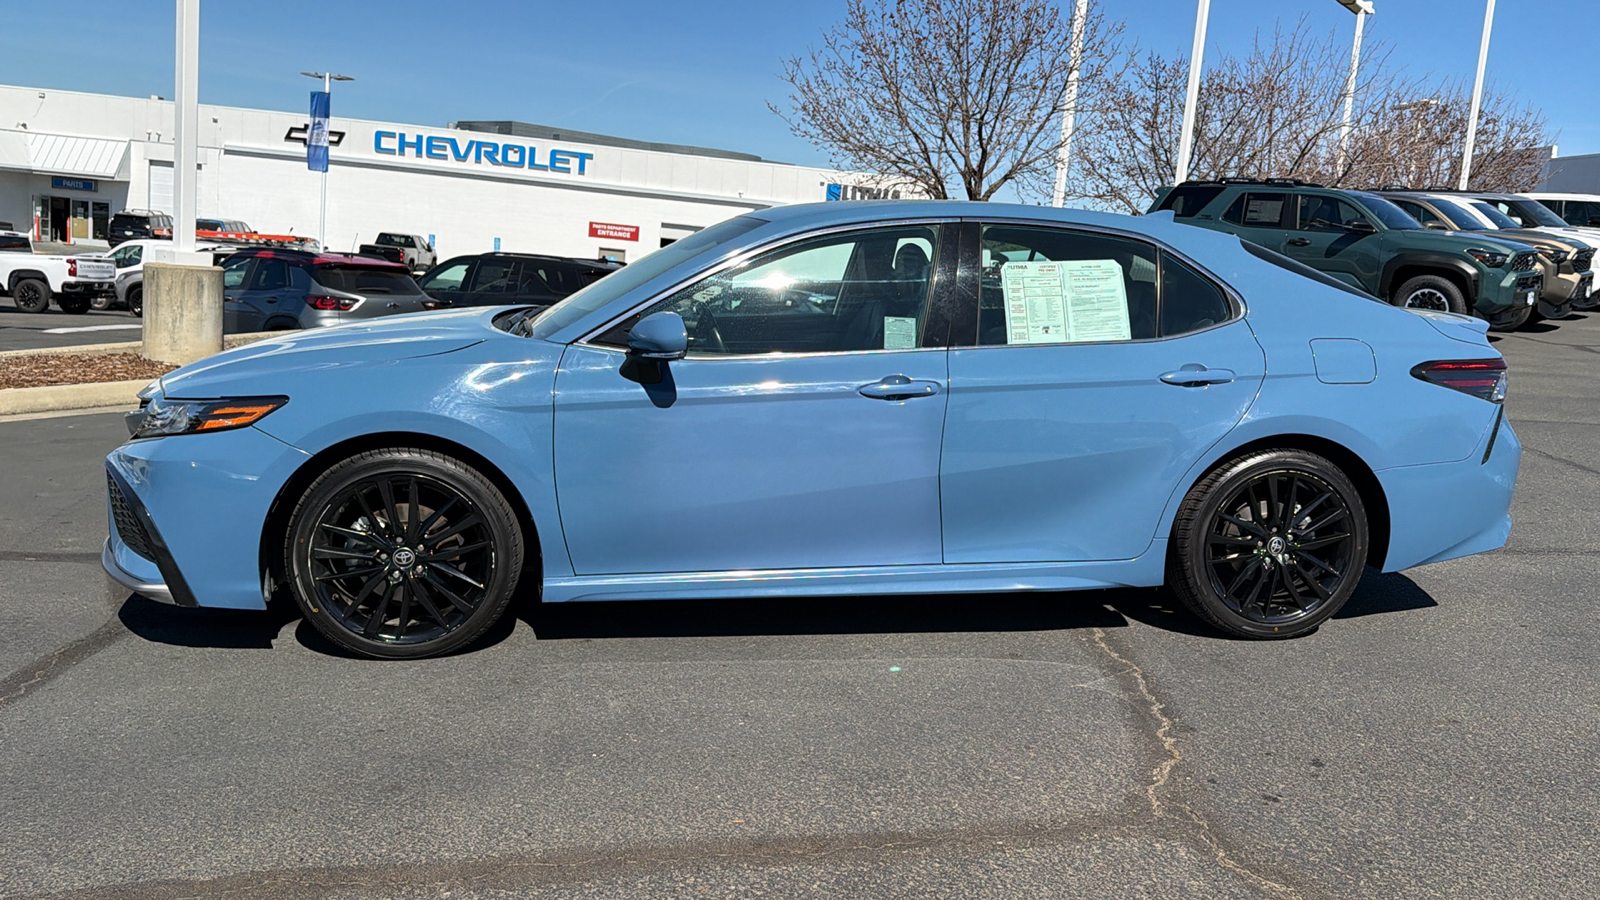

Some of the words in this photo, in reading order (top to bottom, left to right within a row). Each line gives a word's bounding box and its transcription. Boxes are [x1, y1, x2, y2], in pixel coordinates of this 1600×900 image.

[374, 130, 594, 175] CHEVROLET
[62, 179, 84, 189] PARTS
[597, 229, 632, 238] ENTRANCE
